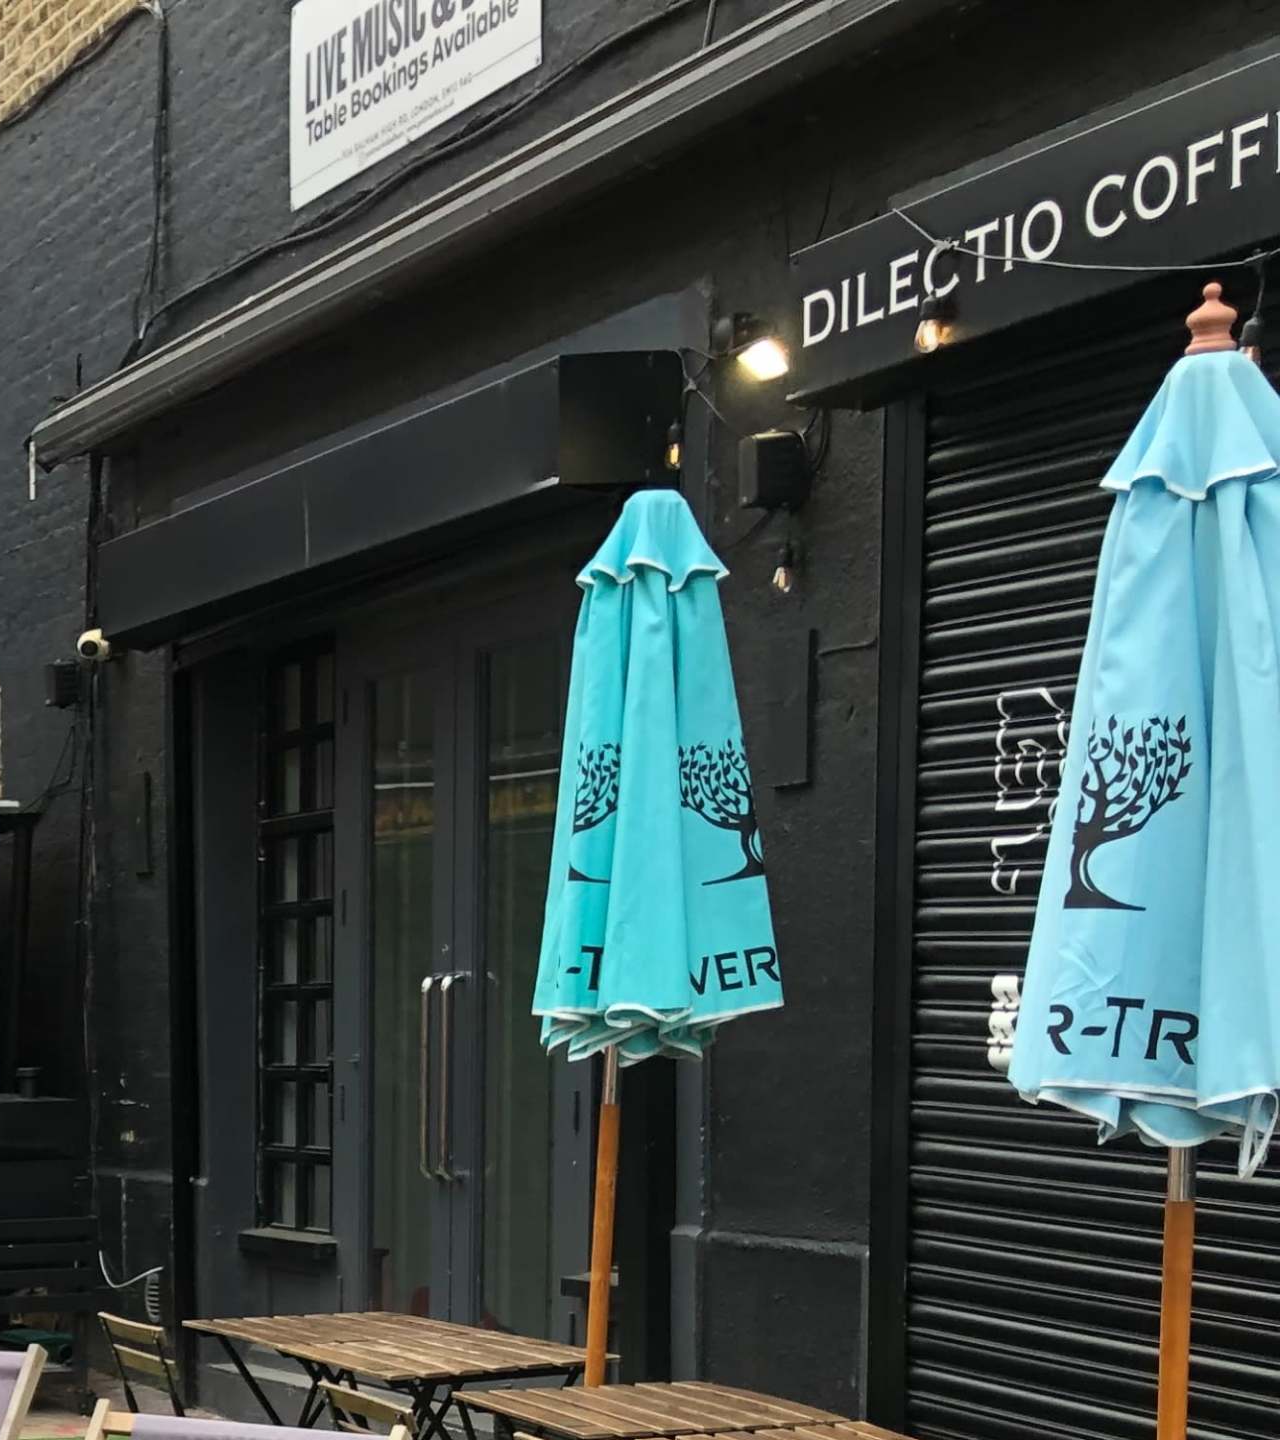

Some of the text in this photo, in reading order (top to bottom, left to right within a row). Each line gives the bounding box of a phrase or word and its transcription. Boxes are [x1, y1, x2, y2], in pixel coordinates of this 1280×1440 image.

[305, 0, 426, 115] LIVE MUSIC
[305, 102, 347, 146] Table
[350, 51, 429, 119] Bookings
[431, 0, 519, 68] Available
[802, 110, 1280, 348] DILECTIO COFF
